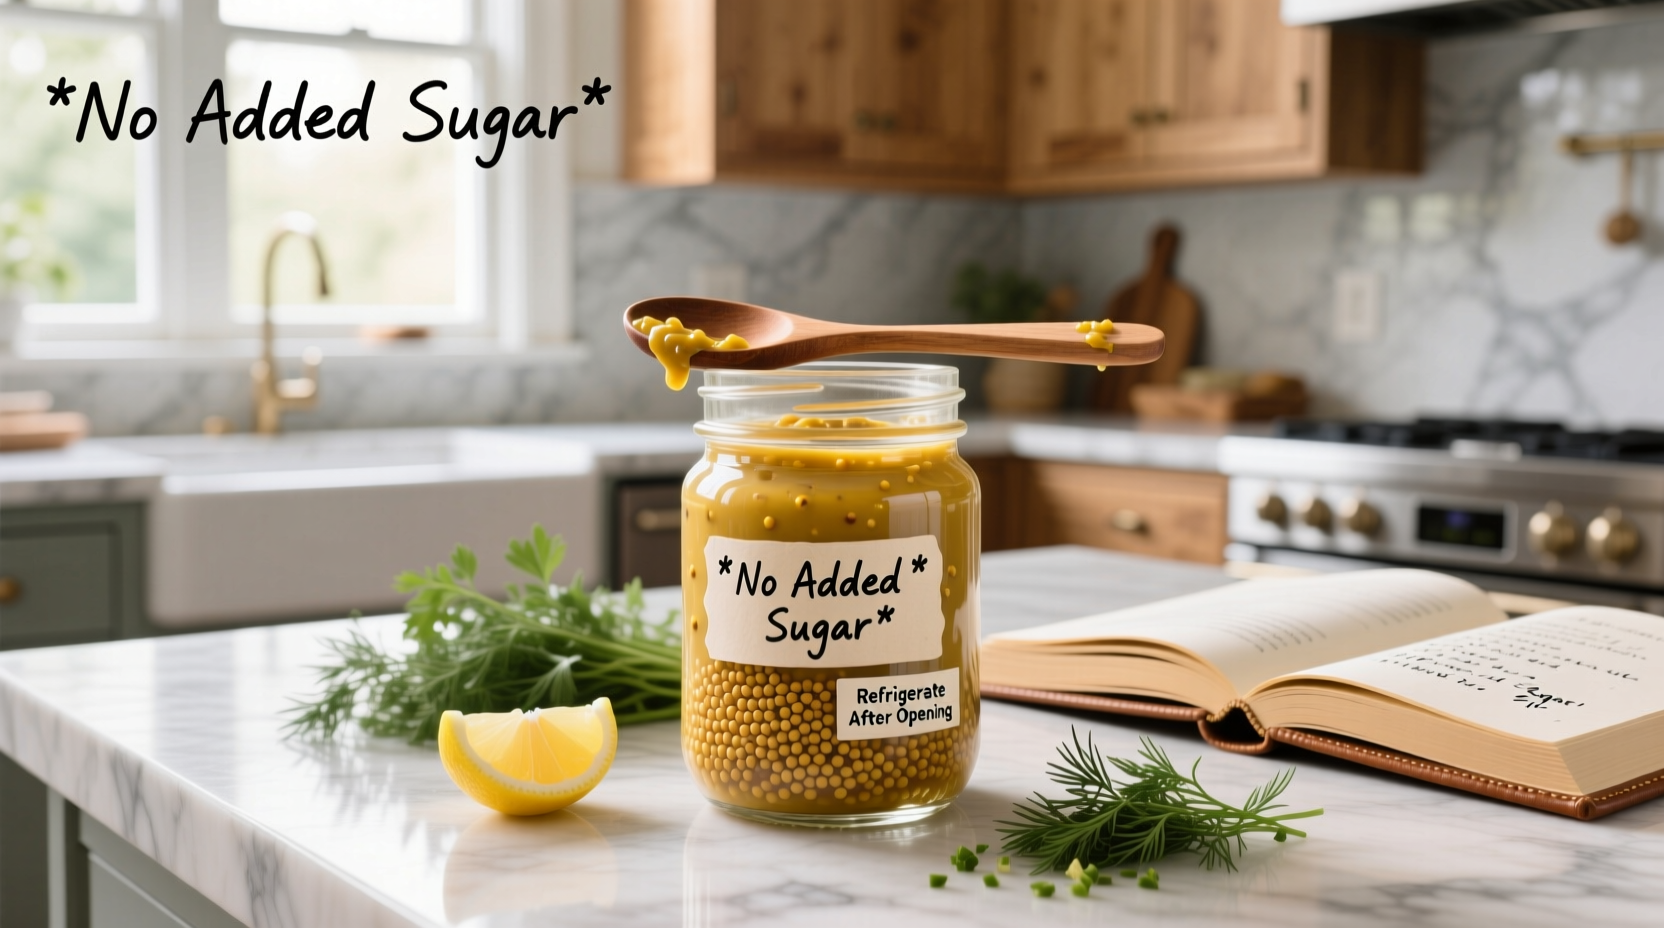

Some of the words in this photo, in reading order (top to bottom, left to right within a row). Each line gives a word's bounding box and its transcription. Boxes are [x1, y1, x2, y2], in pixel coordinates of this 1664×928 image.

[856, 683, 946, 707] Refrigerate
[848, 708, 893, 727] After
[896, 704, 953, 728] Opening
